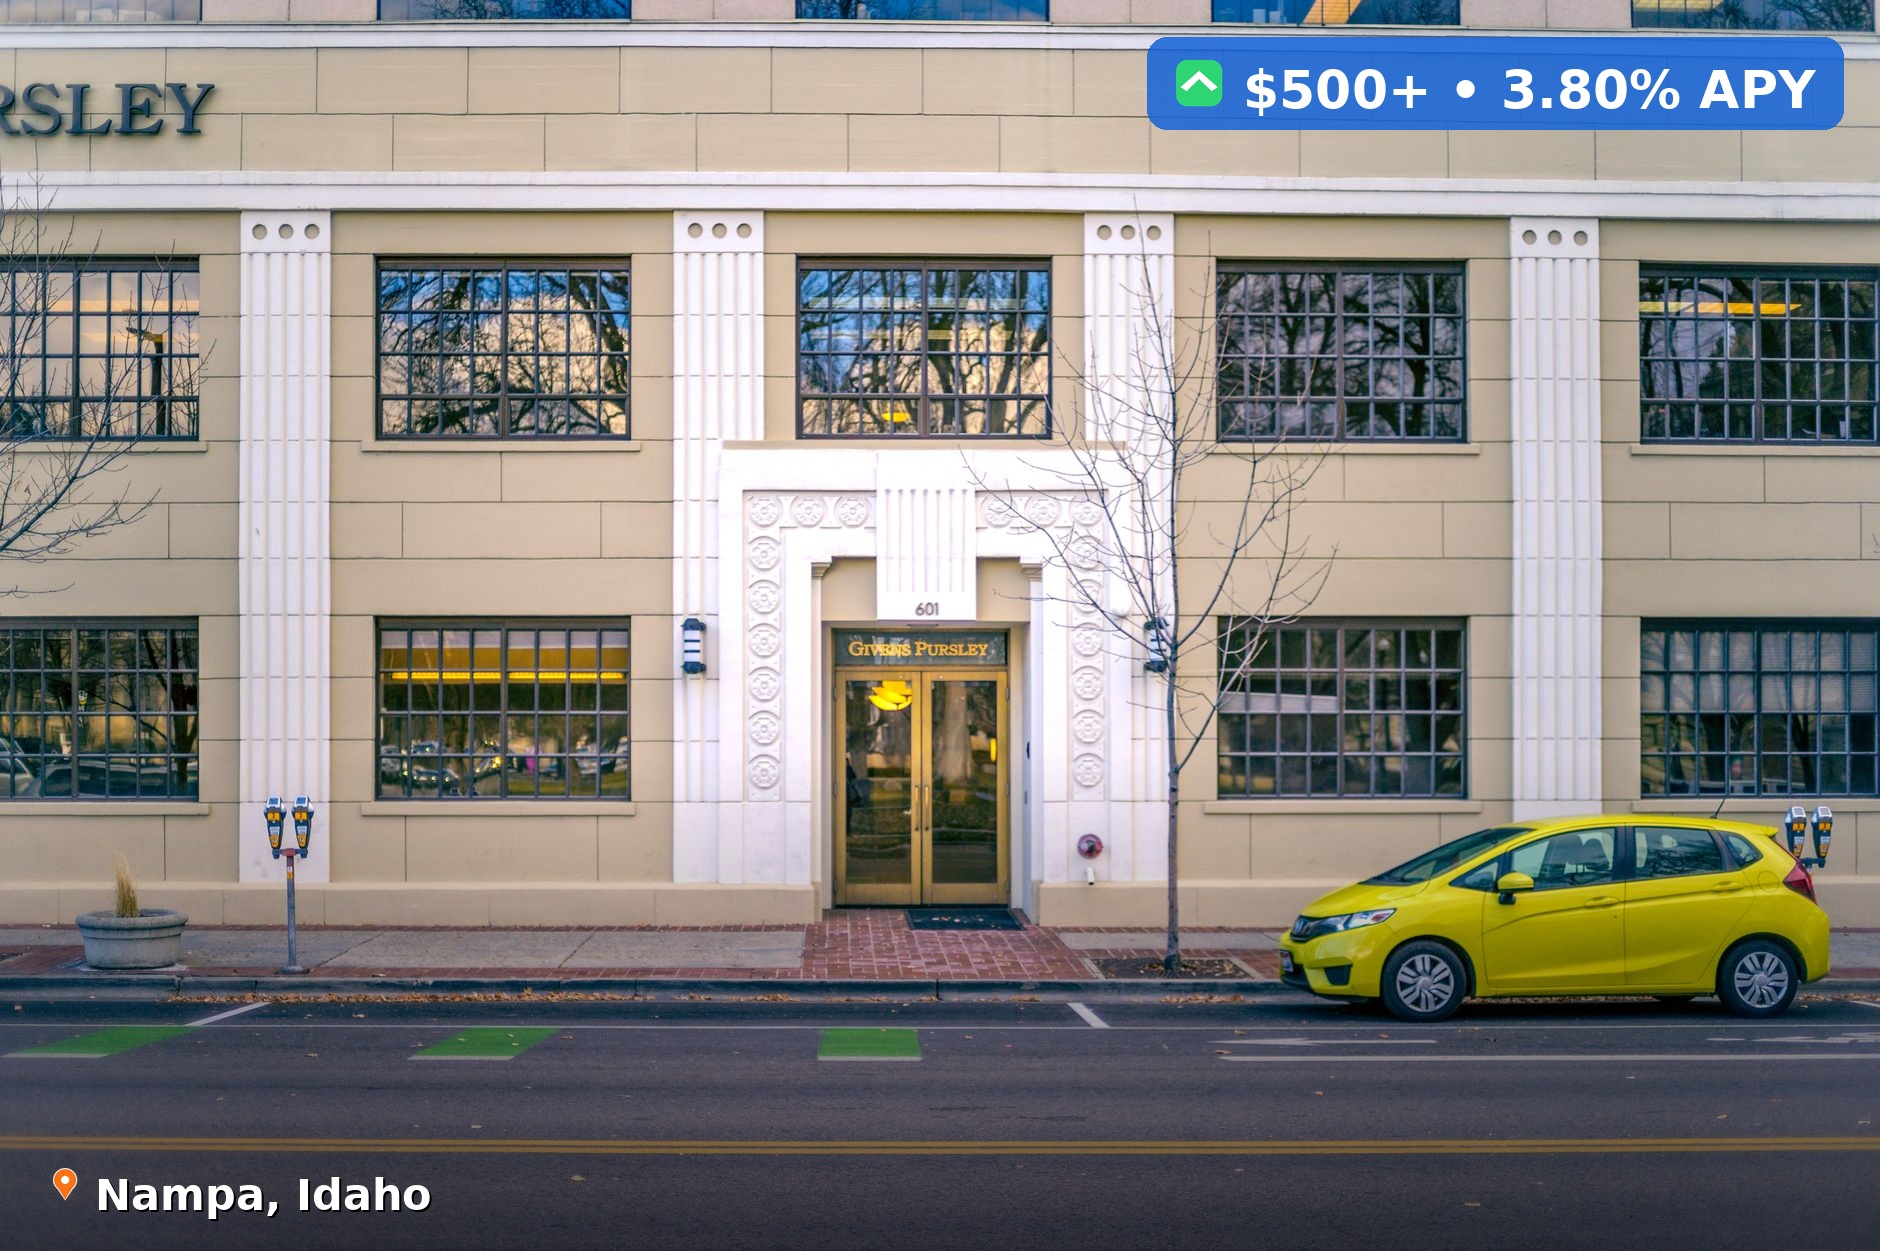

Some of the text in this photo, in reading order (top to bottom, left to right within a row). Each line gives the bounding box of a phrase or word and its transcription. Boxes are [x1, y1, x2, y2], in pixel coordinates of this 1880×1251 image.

[915, 602, 939, 616] 601
[849, 641, 988, 657] GIVENS PURSLEY
